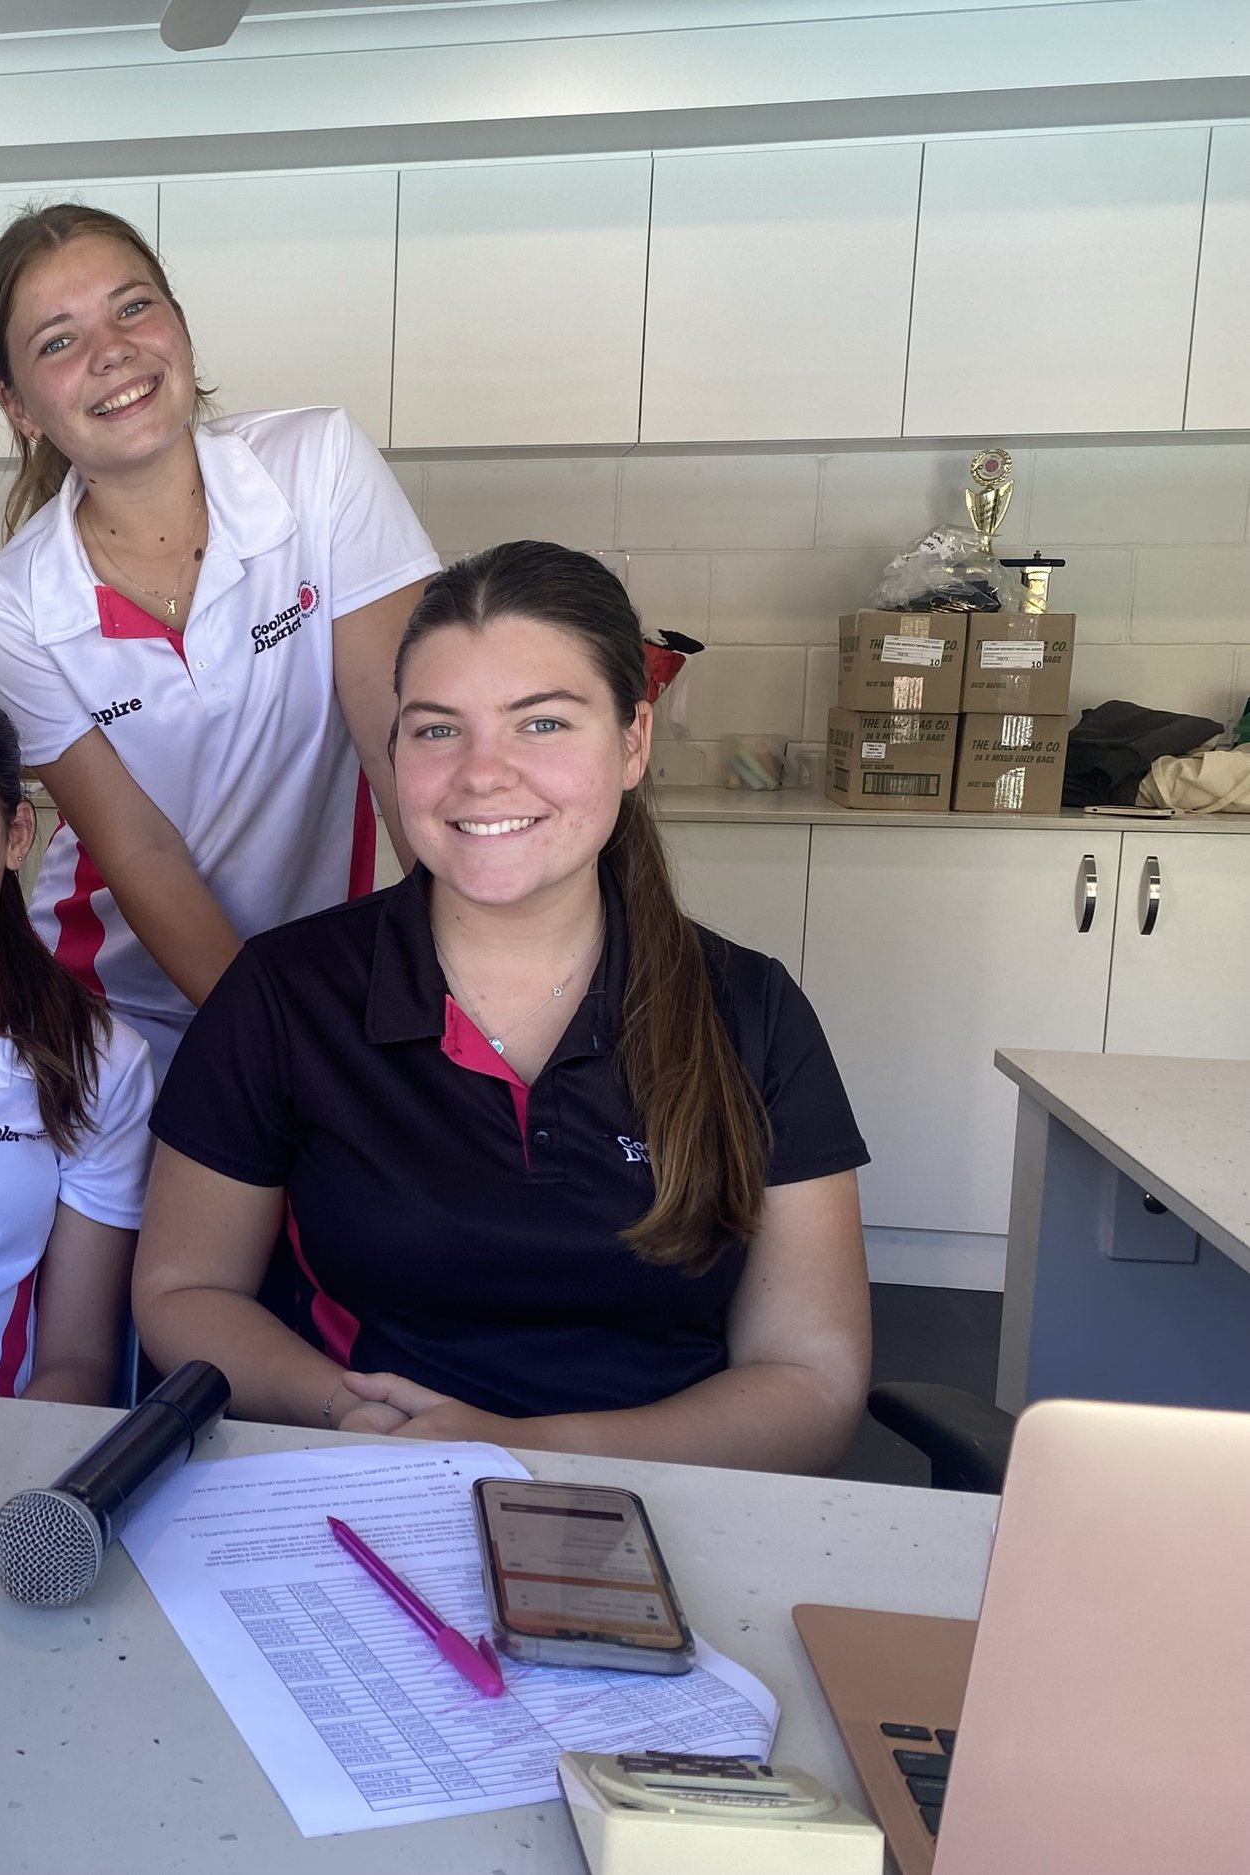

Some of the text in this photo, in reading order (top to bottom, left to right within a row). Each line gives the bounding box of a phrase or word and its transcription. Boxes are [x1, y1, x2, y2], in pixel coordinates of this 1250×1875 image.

[251, 603, 301, 640] Coolum
[254, 616, 301, 654] District
[862, 719, 880, 728] THE
[972, 740, 990, 750] THE
[1046, 742, 1061, 752] CO.
[1015, 755, 1033, 763] LOLLY
